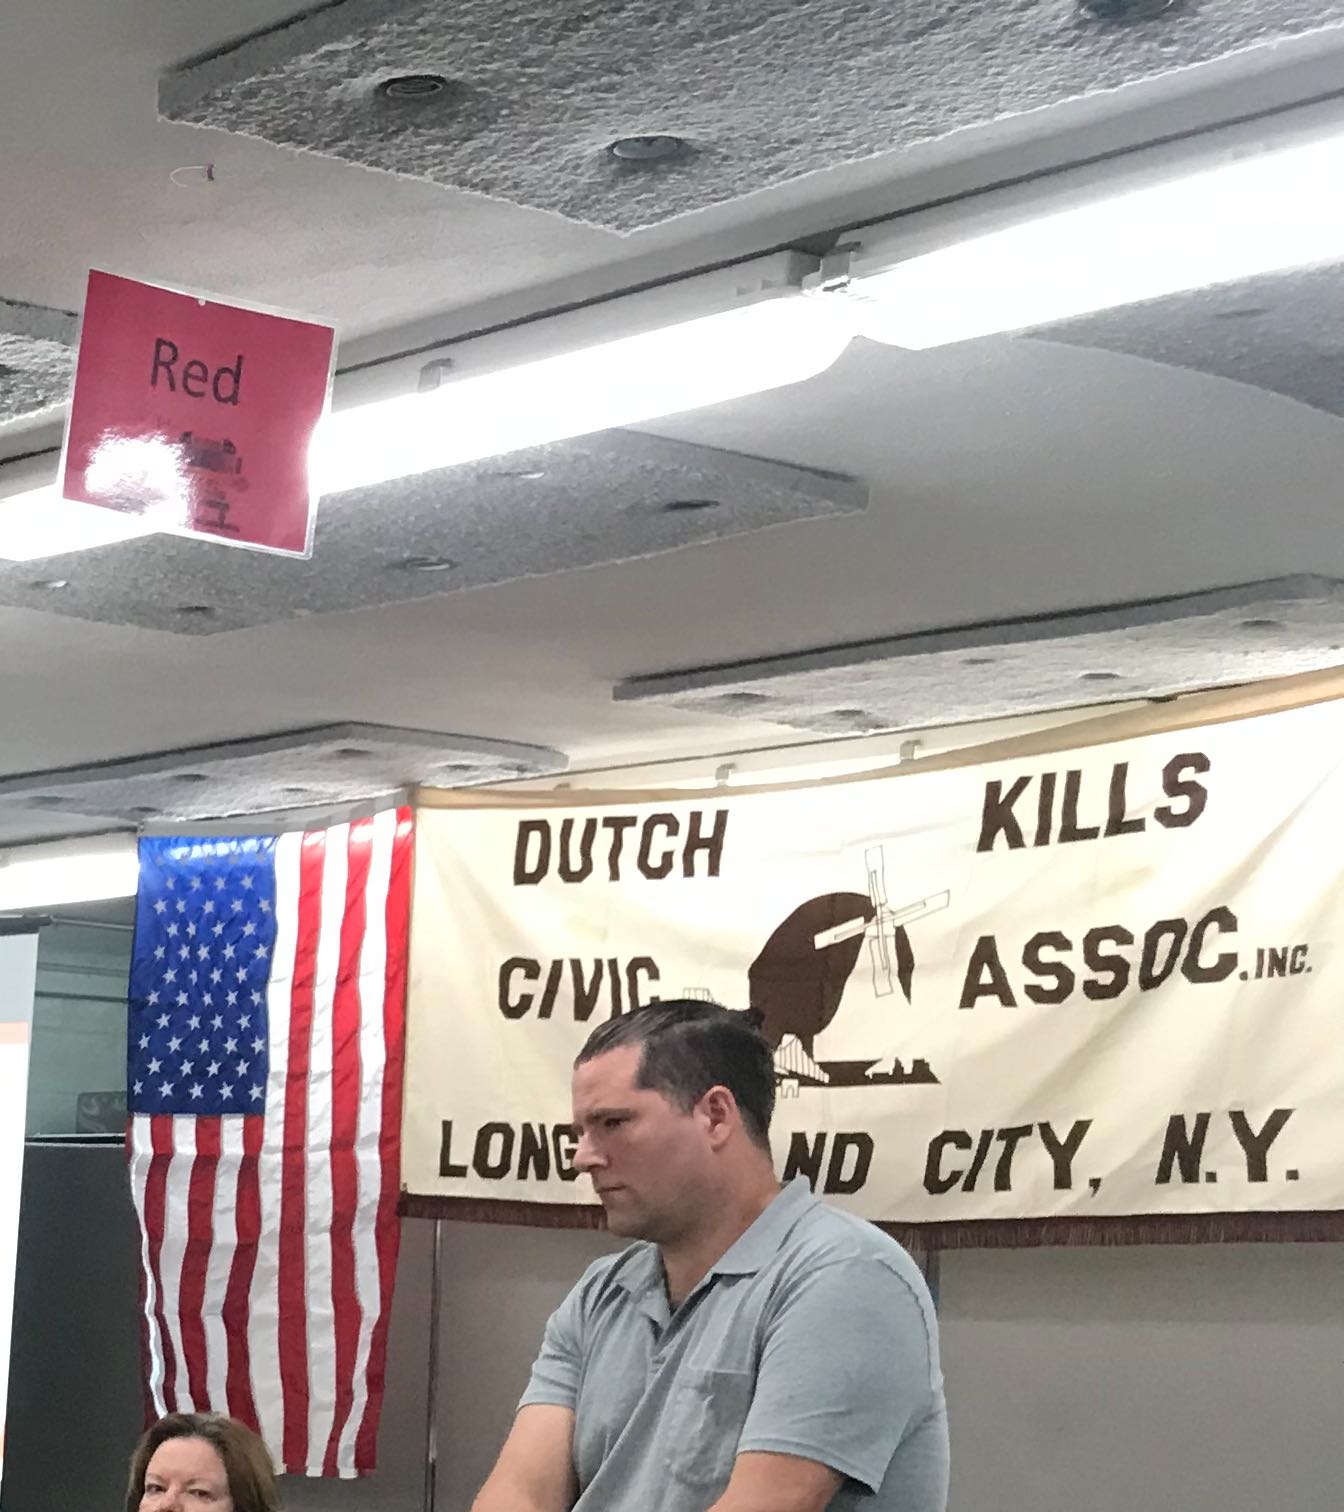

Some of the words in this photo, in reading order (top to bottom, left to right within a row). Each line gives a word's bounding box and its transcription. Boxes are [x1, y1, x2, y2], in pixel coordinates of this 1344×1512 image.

[150, 336, 244, 406] Red
[512, 809, 730, 886] DUTCH
[977, 752, 1212, 853] KILLS
[498, 956, 661, 1022] CIVIC
[923, 1118, 1102, 1198] CITY,
[1154, 1107, 1300, 1185] N.Y.
